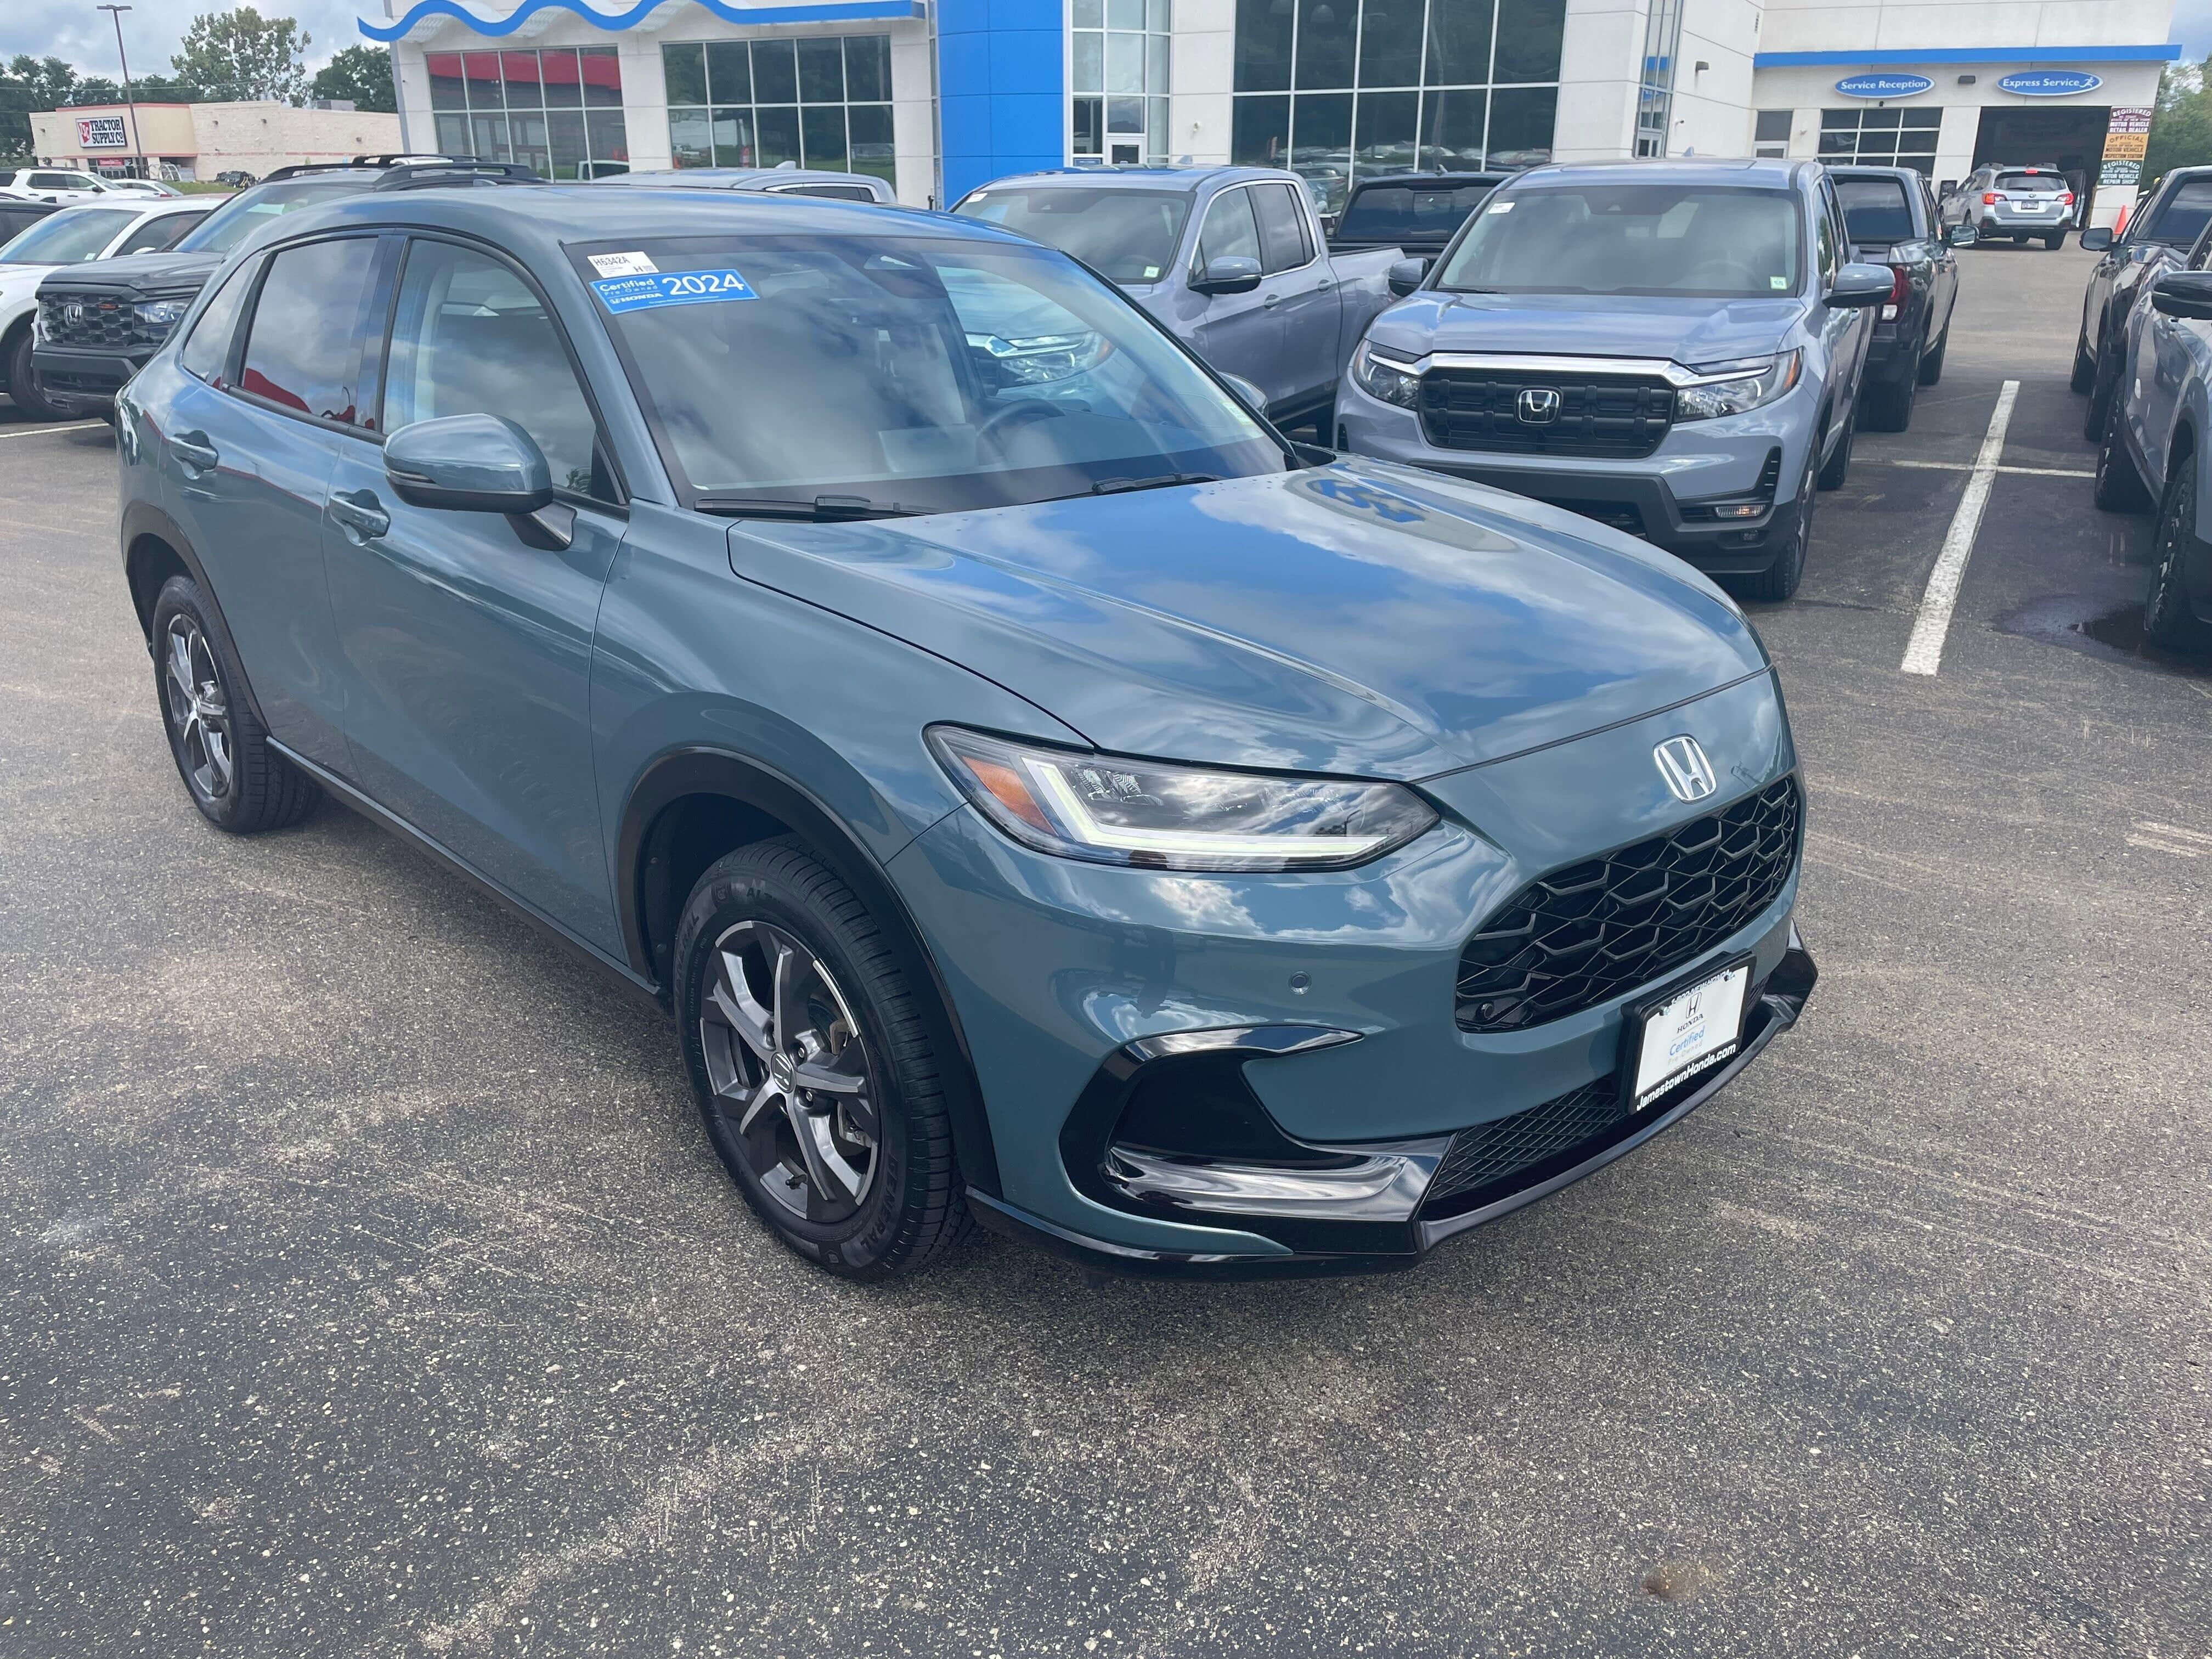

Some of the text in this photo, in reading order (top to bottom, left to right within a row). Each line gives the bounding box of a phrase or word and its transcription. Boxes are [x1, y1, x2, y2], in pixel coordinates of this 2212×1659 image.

[1841, 80, 1927, 90] Service Reception
[2002, 78, 2080, 88] Express Service
[2112, 108, 2152, 117] REGISTERED
[90, 119, 121, 131] TRACTOR
[92, 132, 115, 144] SUPPLY
[2109, 135, 2145, 143] OFFICIAL
[2103, 160, 2140, 170] REGISTERED
[593, 256, 630, 266] H6342A
[599, 278, 656, 292] Certified
[662, 274, 745, 296] 2024
[620, 293, 664, 302] HONDA
[1676, 1013, 1704, 1034] HONDA
[1669, 1025, 1706, 1056] Certified
[1636, 1043, 1737, 1111] JamestownHonda.com
